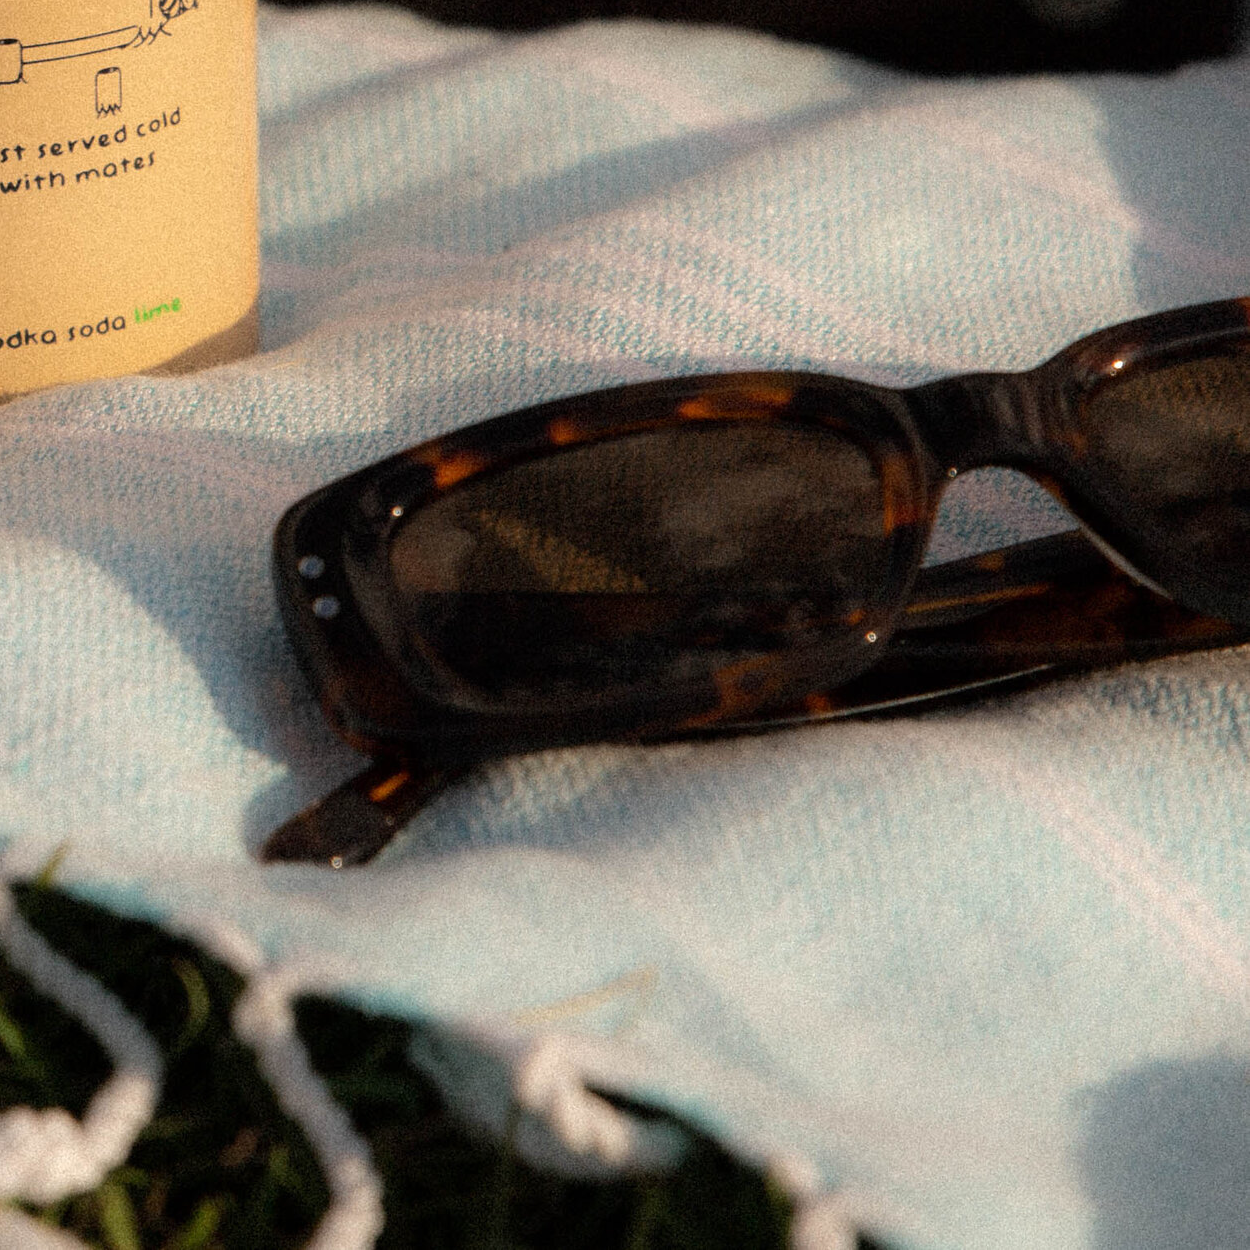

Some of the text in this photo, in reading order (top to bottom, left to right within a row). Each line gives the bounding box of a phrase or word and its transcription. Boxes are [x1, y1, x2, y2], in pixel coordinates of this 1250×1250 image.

[37, 124, 127, 159] served
[135, 106, 182, 138] cold
[0, 151, 156, 194] with mates
[66, 315, 127, 342] soda
[133, 297, 183, 324] lime
